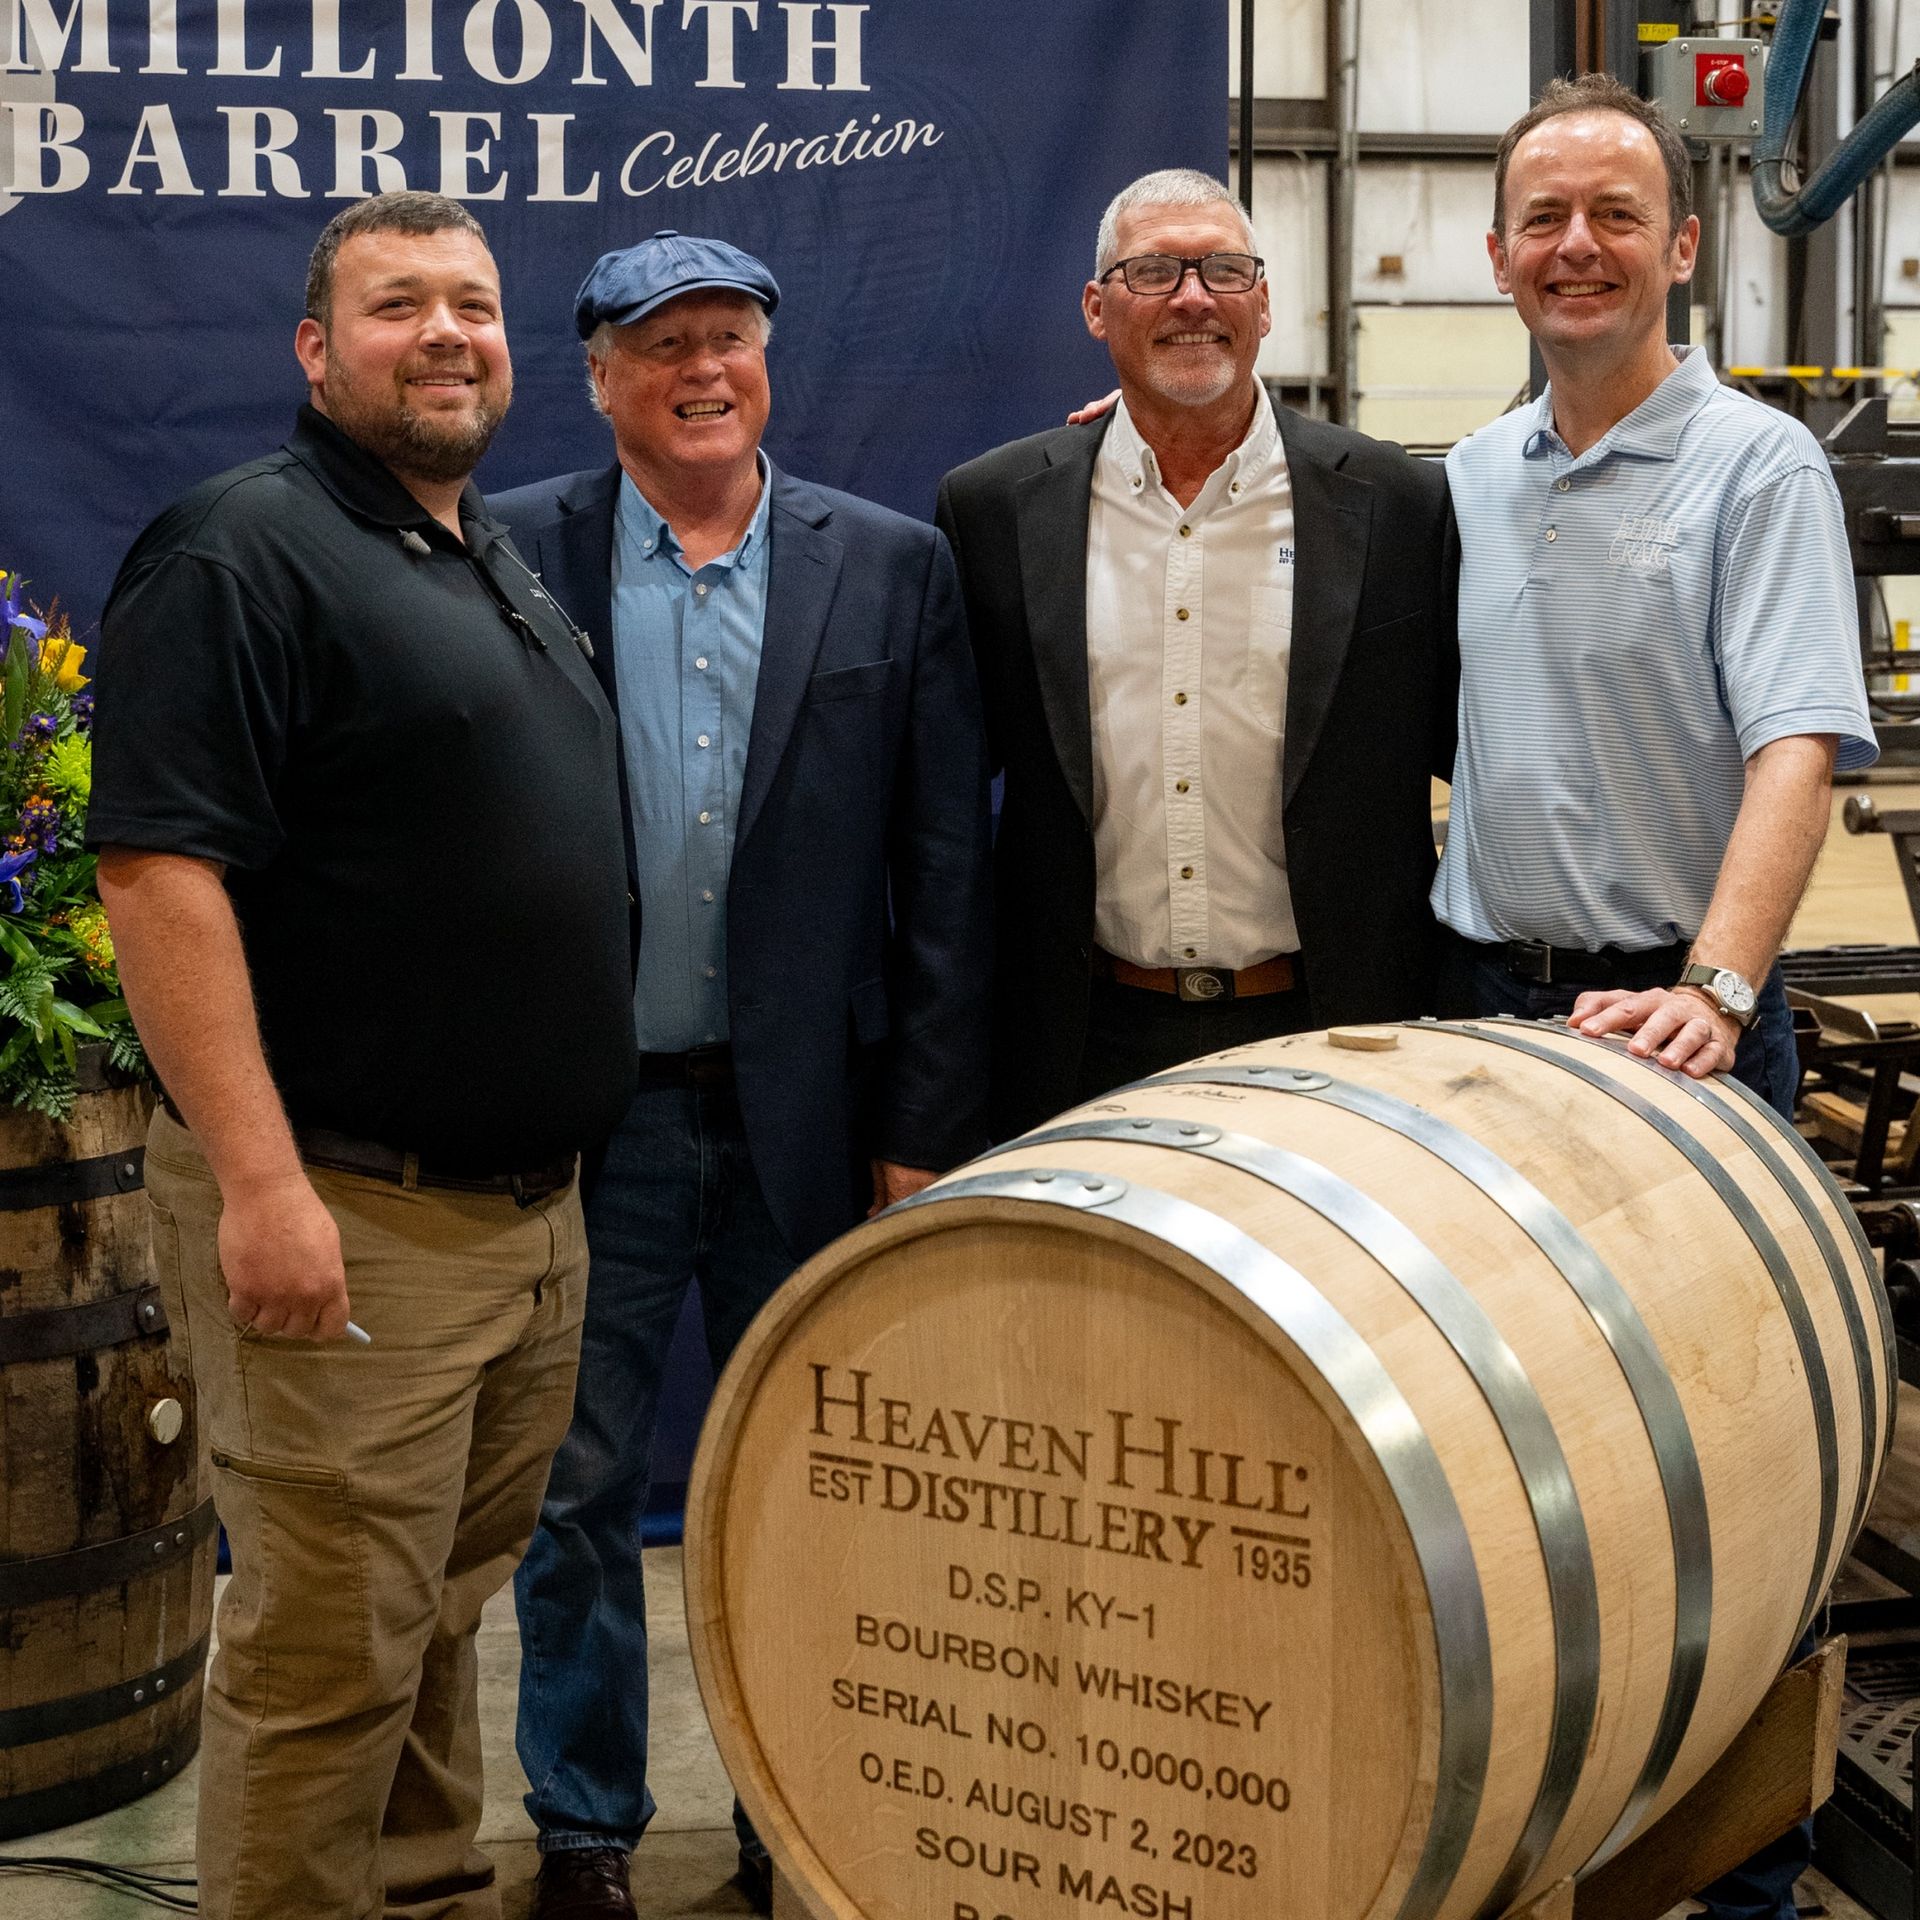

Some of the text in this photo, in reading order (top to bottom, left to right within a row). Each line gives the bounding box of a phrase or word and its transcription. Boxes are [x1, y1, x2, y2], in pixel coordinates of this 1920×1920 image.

[2, 0, 871, 93] MILLIONTH
[2, 101, 945, 203] BARREL Celebration
[807, 1361, 1095, 1482] HEAVEN
[808, 1463, 1312, 1589] EST DISTILLERY 1935
[948, 1564, 1156, 1639] D.S.P. KY-1
[855, 1613, 1272, 1733] BOURBON WHISKEY
[831, 1677, 1292, 1813] SERIAL NO. 10,000,000
[859, 1751, 1258, 1879] O.E.D. AUGUST 2, 2023
[914, 1826, 1193, 1920] SOUR MASH
